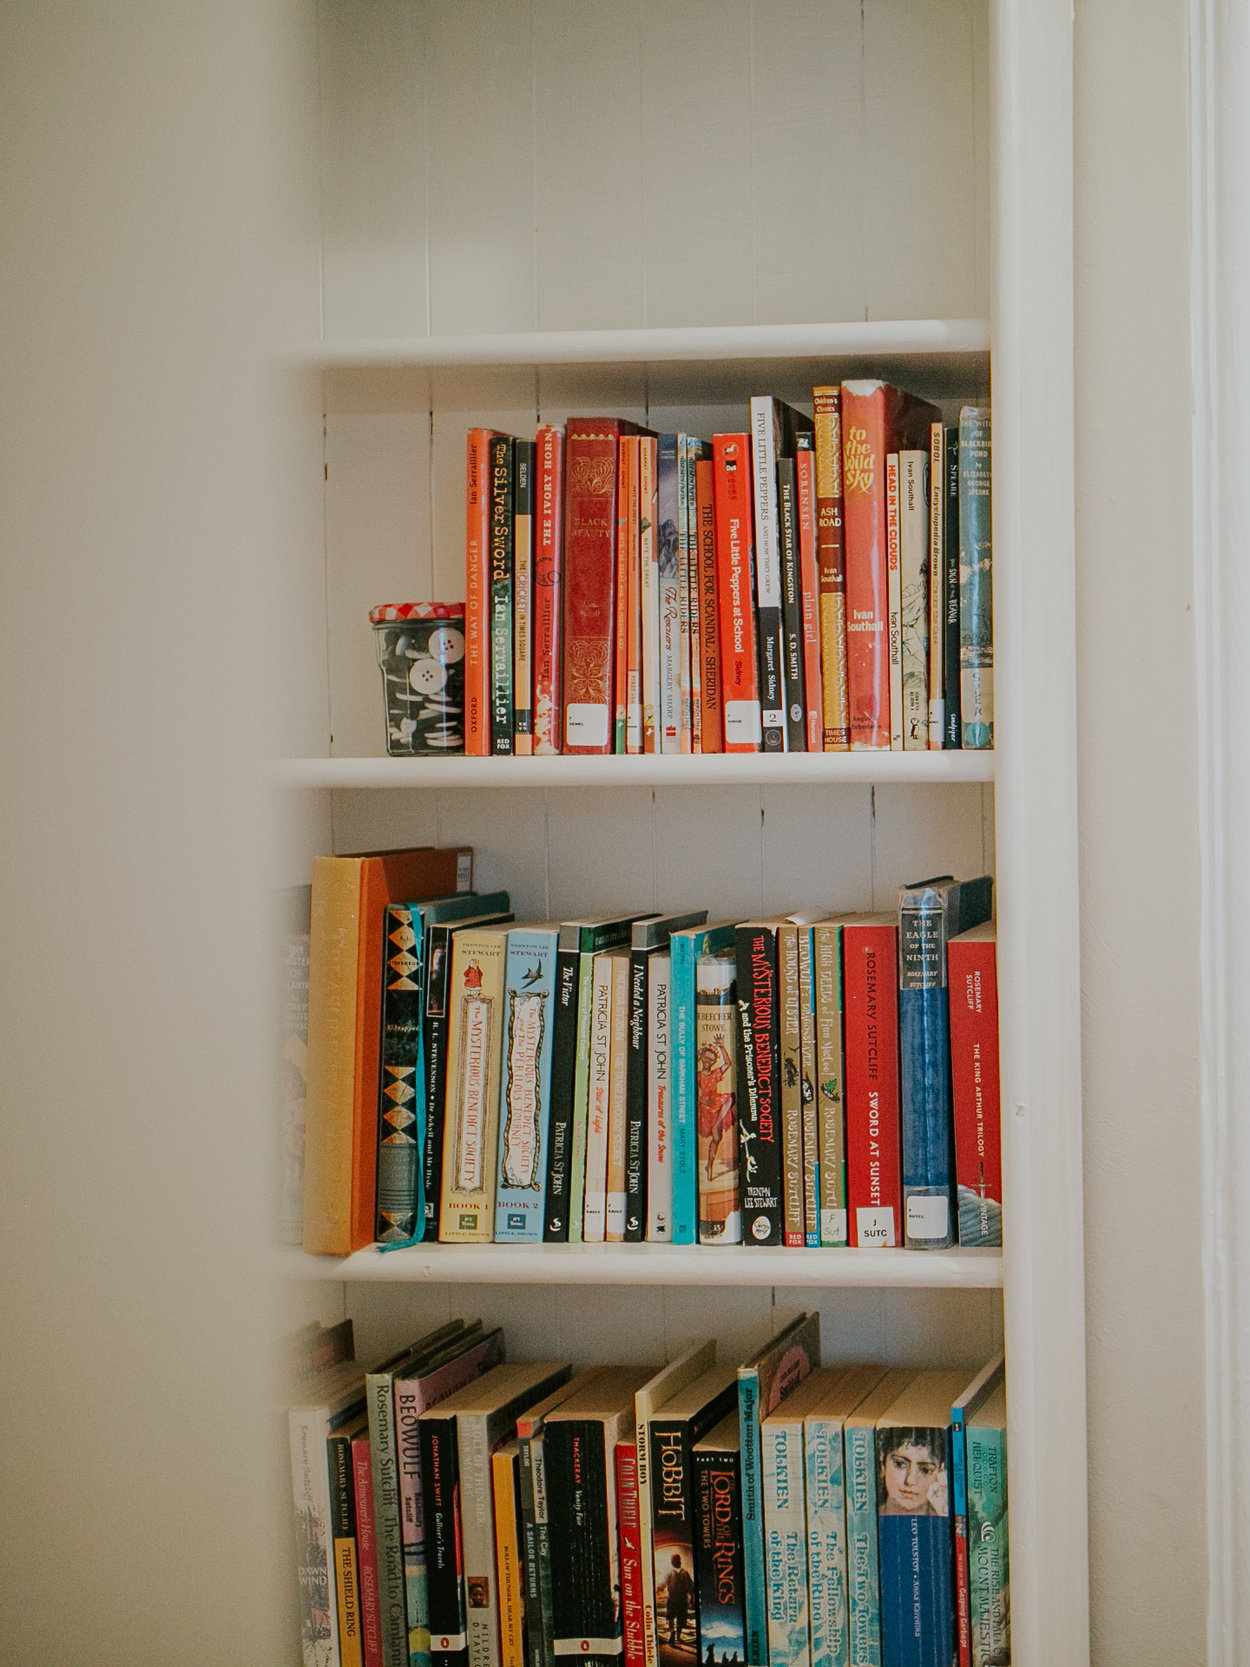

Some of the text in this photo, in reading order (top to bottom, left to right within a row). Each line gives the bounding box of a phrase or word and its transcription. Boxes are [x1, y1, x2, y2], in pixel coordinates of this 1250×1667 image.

[847, 441, 871, 455] the
[849, 427, 866, 441] to
[469, 444, 477, 488] Serraillier
[519, 463, 527, 488] SELDEN
[543, 433, 553, 546] THE IVORY HORN
[757, 413, 769, 521] FIVE LITTLE PEPPERS
[888, 465, 897, 492] HEAD
[493, 444, 509, 580] The Silver Sword
[800, 463, 810, 530] SORENSEN
[821, 508, 838, 516] ASH
[889, 495, 896, 504] IN
[907, 480, 915, 511] Southall
[889, 525, 898, 571] CLOUDS
[469, 539, 478, 665] THE WAY OF DANGER
[703, 504, 717, 710] THE SCHOOL FOR SCANDAL SHERIDAN
[730, 519, 744, 653] Five Little Peppers at School
[854, 610, 873, 619] Ivan
[664, 587, 677, 651] The Rescuers
[802, 592, 817, 643] plain girl
[847, 621, 883, 631] Southall
[890, 612, 900, 665] Ivan Southall
[495, 595, 509, 724] Ian Serraillier
[734, 661, 742, 685] Sidney
[766, 636, 776, 701] Margaret Sidney
[561, 967, 573, 1006] The Victor
[633, 970, 643, 998] Needed
[966, 975, 974, 1010] SUTCLIFF
[974, 971, 982, 1013] ROSEMARY
[594, 984, 608, 1082] PATRICIA ST JOHN
[630, 1007, 643, 1049] Neighbour
[654, 984, 666, 1080] PATRICIA ST JOHN
[742, 1013, 750, 1027] and
[743, 1029, 751, 1041] the
[751, 936, 774, 1143] THE MYSTERIOUS BENEDICT SOCIETY
[866, 952, 877, 1080] ROSEMARY SUTCLIFF
[468, 1020, 482, 1086] MYSTERIOUS
[466, 1090, 479, 1137] BENEDICT
[748, 1088, 759, 1122] Dilemma
[975, 1087, 983, 1119] ARTHUR
[464, 1140, 476, 1184] SOCIETY
[868, 1092, 881, 1206] SWORD AT SUNSET
[864, 1229, 887, 1237] SUTC
[980, 1202, 989, 1236] VINTAGE
[376, 1384, 391, 1453] Rosemary
[399, 1394, 419, 1479] BEOWULF
[431, 1435, 440, 1479] JONATHAN
[573, 1437, 581, 1484] THACKERAY
[637, 1424, 647, 1485] STORM BOY
[774, 1431, 788, 1509] TOLKIEN
[815, 1431, 829, 1510] TOLKIEN
[853, 1433, 867, 1513] TOLKIEN
[534, 1458, 545, 1519] Theodore Taylor
[701, 1490, 709, 1510] TWO
[702, 1513, 711, 1549] TOWERS
[342, 1547, 356, 1637] THE SHIELD RING
[714, 1542, 735, 1604] RINGS
[770, 1531, 783, 1621] of the King
[786, 1531, 799, 1624] The Return
[825, 1532, 840, 1655] The Fellowship
[856, 1534, 870, 1663] The Two Towers
[623, 1558, 643, 1659] Sun on the Stubble
[978, 1546, 992, 1659] MOUNT MAJESTIC
